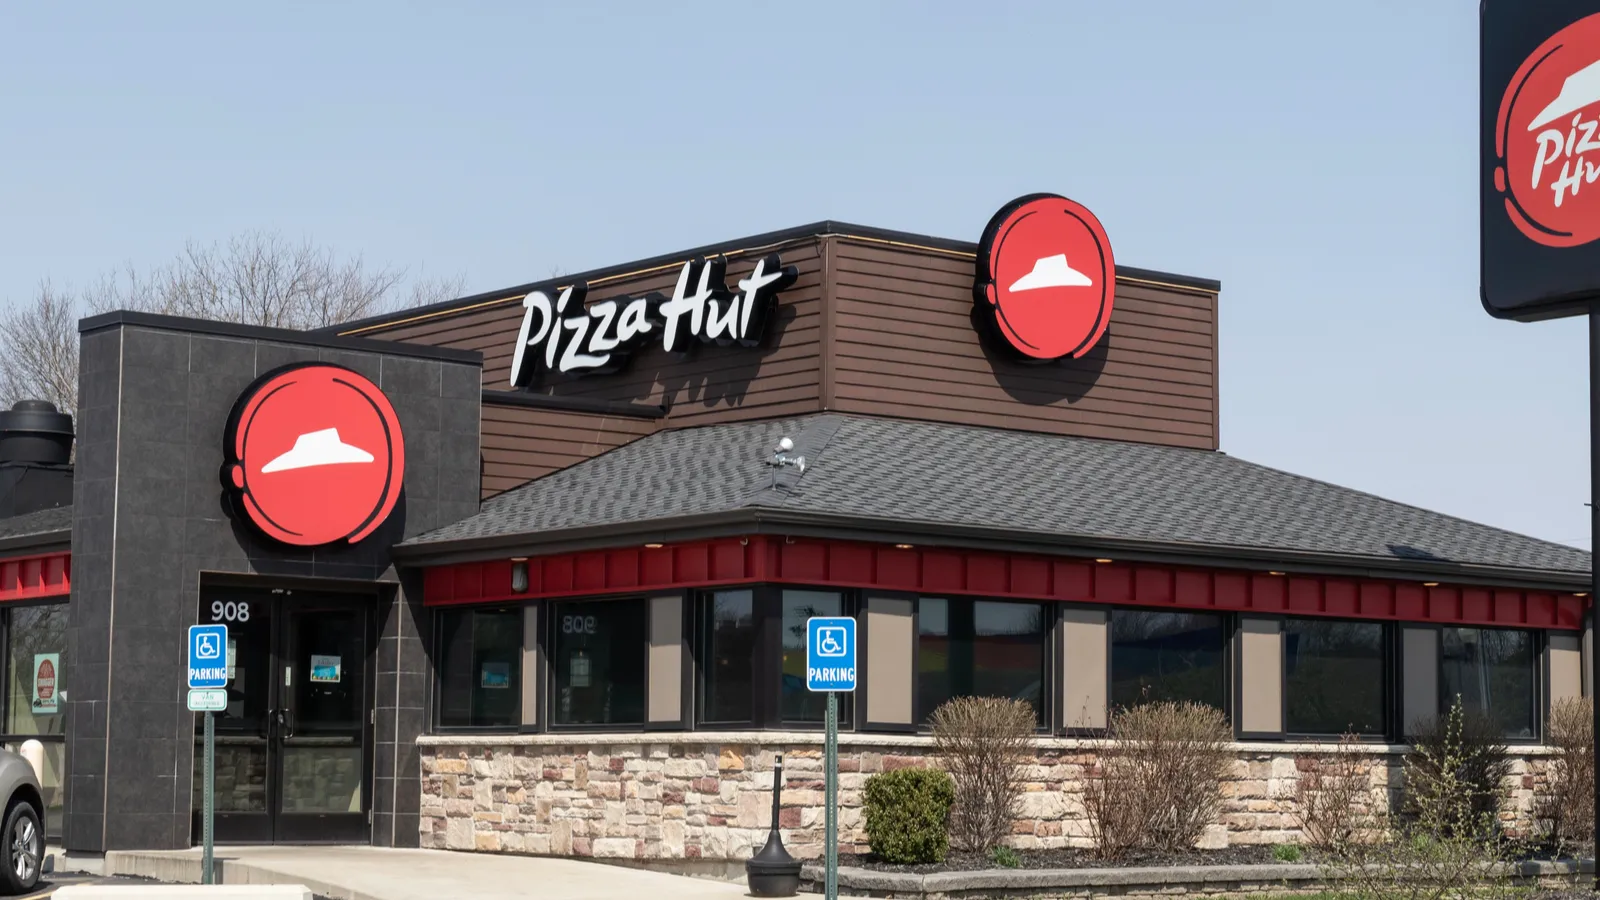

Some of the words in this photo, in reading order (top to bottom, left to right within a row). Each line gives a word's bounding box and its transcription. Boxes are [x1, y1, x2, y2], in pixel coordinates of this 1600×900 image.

[1532, 112, 1600, 189] Piz
[510, 285, 652, 387] Pizza
[659, 258, 783, 352] Hut
[211, 601, 250, 622] 908
[190, 667, 226, 680] PARKING
[809, 667, 855, 682] PARKING
